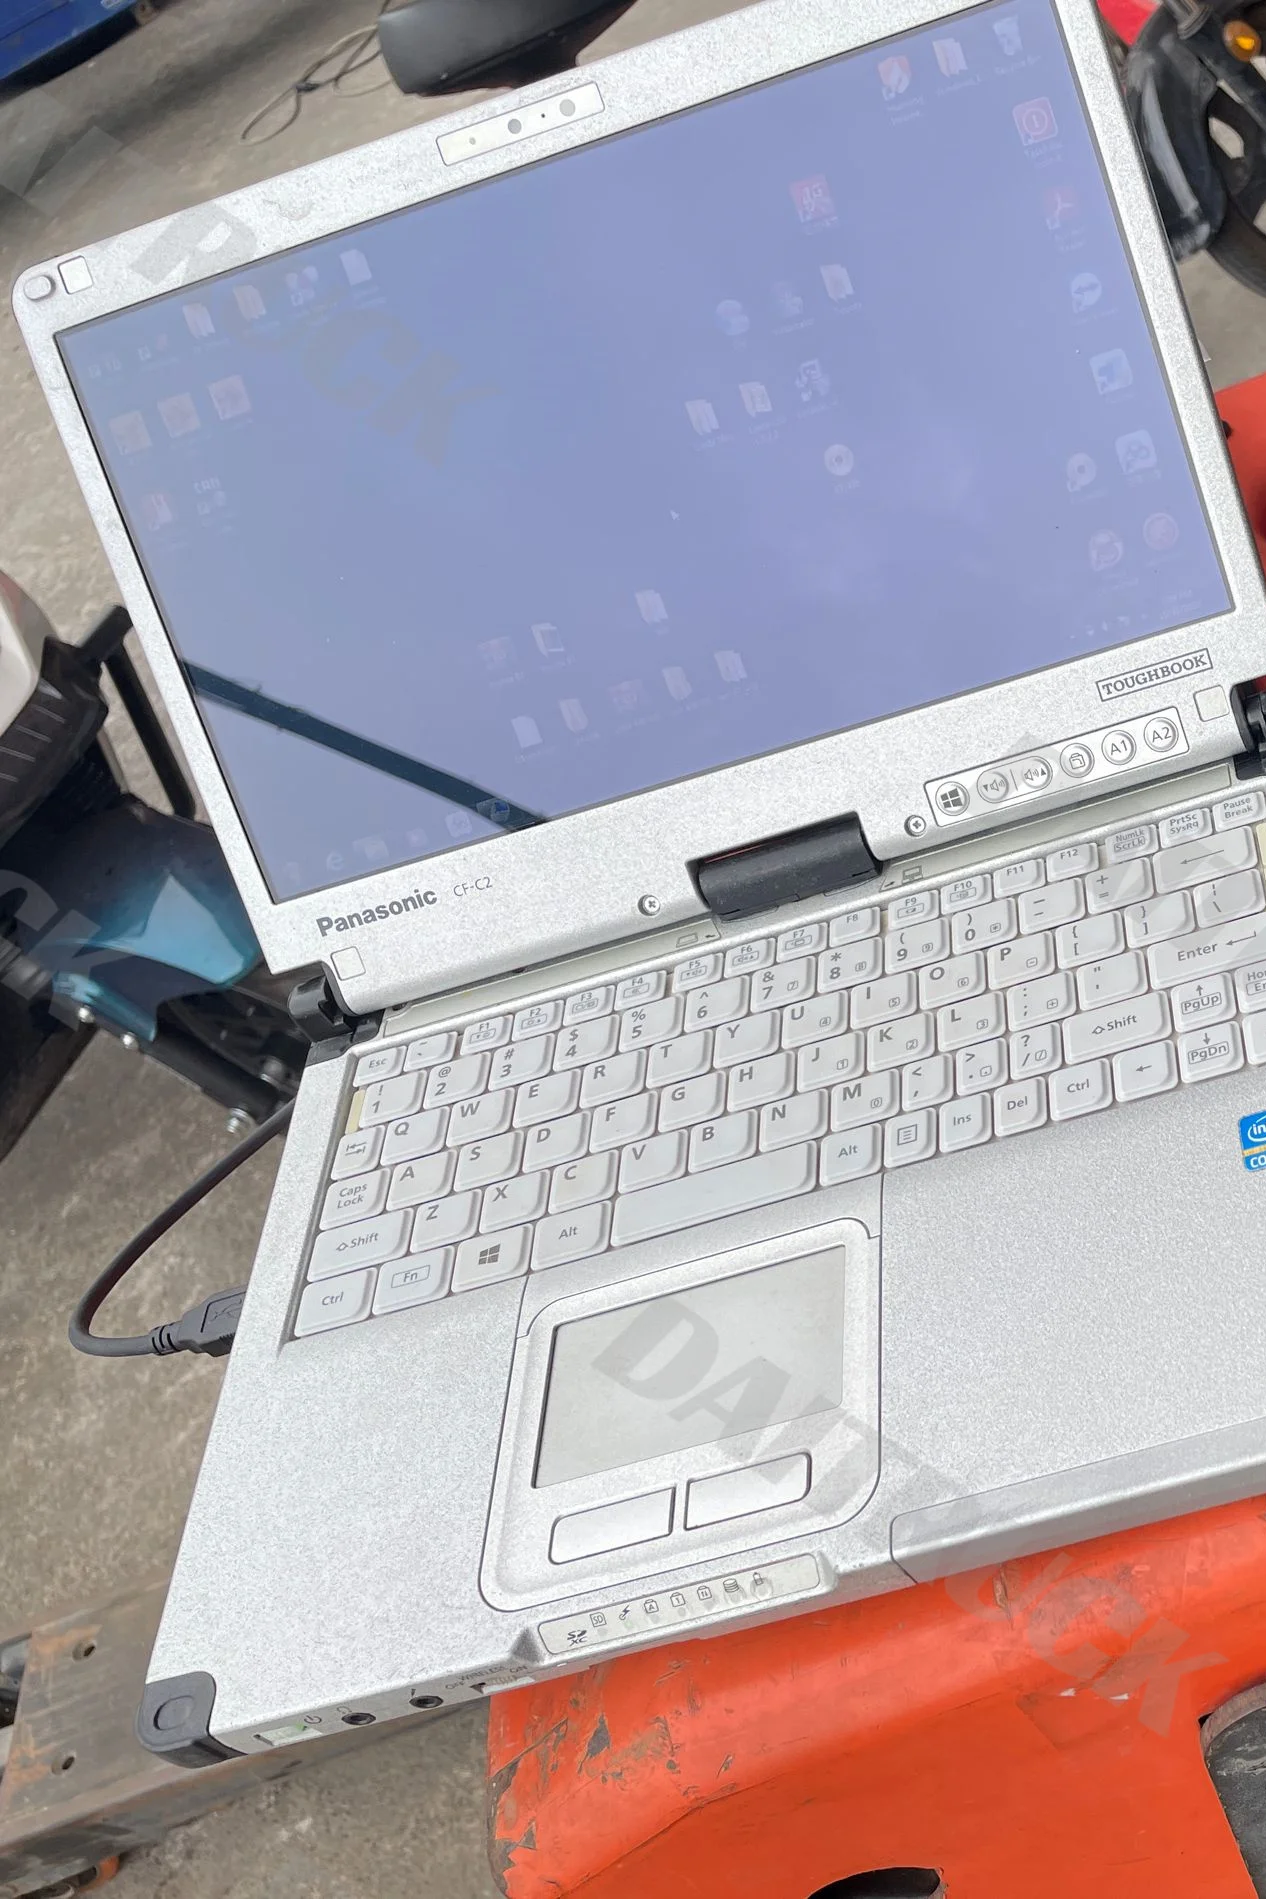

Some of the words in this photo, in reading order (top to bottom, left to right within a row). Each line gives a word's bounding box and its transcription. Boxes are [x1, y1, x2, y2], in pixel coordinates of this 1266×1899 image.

[1102, 654, 1207, 695] TOUGHBOOK
[1152, 727, 1172, 743] A2
[1110, 739, 1128, 756] A1
[1223, 798, 1250, 810] Pause
[1224, 805, 1253, 819] Break
[1167, 814, 1197, 827] PrtSc
[1170, 821, 1199, 834] SysRq
[1060, 848, 1078, 860] F12
[1006, 865, 1024, 876] F11
[951, 880, 972, 892] F10
[316, 889, 438, 937] Panasonic
[453, 876, 493, 897] CF-C2
[905, 897, 917, 906] F9
[846, 914, 858, 924] F8
[793, 929, 805, 939] F7
[964, 928, 976, 941] 0
[740, 945, 752, 954] F6
[897, 948, 908, 962] 9
[1000, 947, 1012, 961] P
[1177, 943, 1218, 962] Enter
[689, 960, 700, 969] F5
[829, 966, 841, 980] 8
[929, 966, 945, 980] O
[630, 977, 643, 986] F4
[580, 992, 592, 1002] F3
[762, 985, 774, 1000] 7
[866, 986, 871, 1000] I
[529, 1007, 542, 1017] F2
[697, 1005, 708, 1019] 6
[1182, 996, 1221, 1014] PgUp
[791, 1006, 804, 1020] U
[950, 1009, 962, 1022] L
[479, 1022, 490, 1032] F1
[1107, 1015, 1137, 1031] Shift
[632, 1024, 642, 1039] 5
[726, 1024, 740, 1039] Y
[879, 1026, 893, 1042] K
[565, 1044, 577, 1057] 4
[660, 1044, 673, 1058] T
[811, 1047, 820, 1062] J
[1190, 1045, 1229, 1061] PgDn
[368, 1058, 386, 1069] Esc
[500, 1064, 512, 1078] 3
[593, 1064, 606, 1080] R
[739, 1066, 753, 1082] H
[434, 1082, 446, 1096] 2
[528, 1084, 540, 1098] E
[842, 1083, 862, 1101] M
[1067, 1078, 1090, 1093] Ctrl
[671, 1086, 685, 1102] G
[372, 1100, 380, 1114] 1
[460, 1100, 481, 1118] W
[1007, 1096, 1028, 1110] Del
[605, 1106, 616, 1122] F
[771, 1104, 786, 1121] N
[953, 1114, 972, 1126] Ins
[394, 1122, 410, 1136] Q
[536, 1128, 551, 1143] D
[702, 1126, 714, 1142] B
[469, 1146, 482, 1161] S
[632, 1144, 646, 1160] V
[838, 1145, 858, 1158] Alt
[399, 1166, 415, 1182] A
[564, 1165, 577, 1180] C
[339, 1184, 367, 1198] Caps
[492, 1184, 509, 1202] X
[337, 1193, 364, 1209] Lock
[426, 1204, 439, 1221] Z
[351, 1232, 378, 1248] Shift
[558, 1226, 577, 1240] Alt
[403, 1271, 418, 1282] Fn
[322, 1291, 344, 1306] Ctrl
